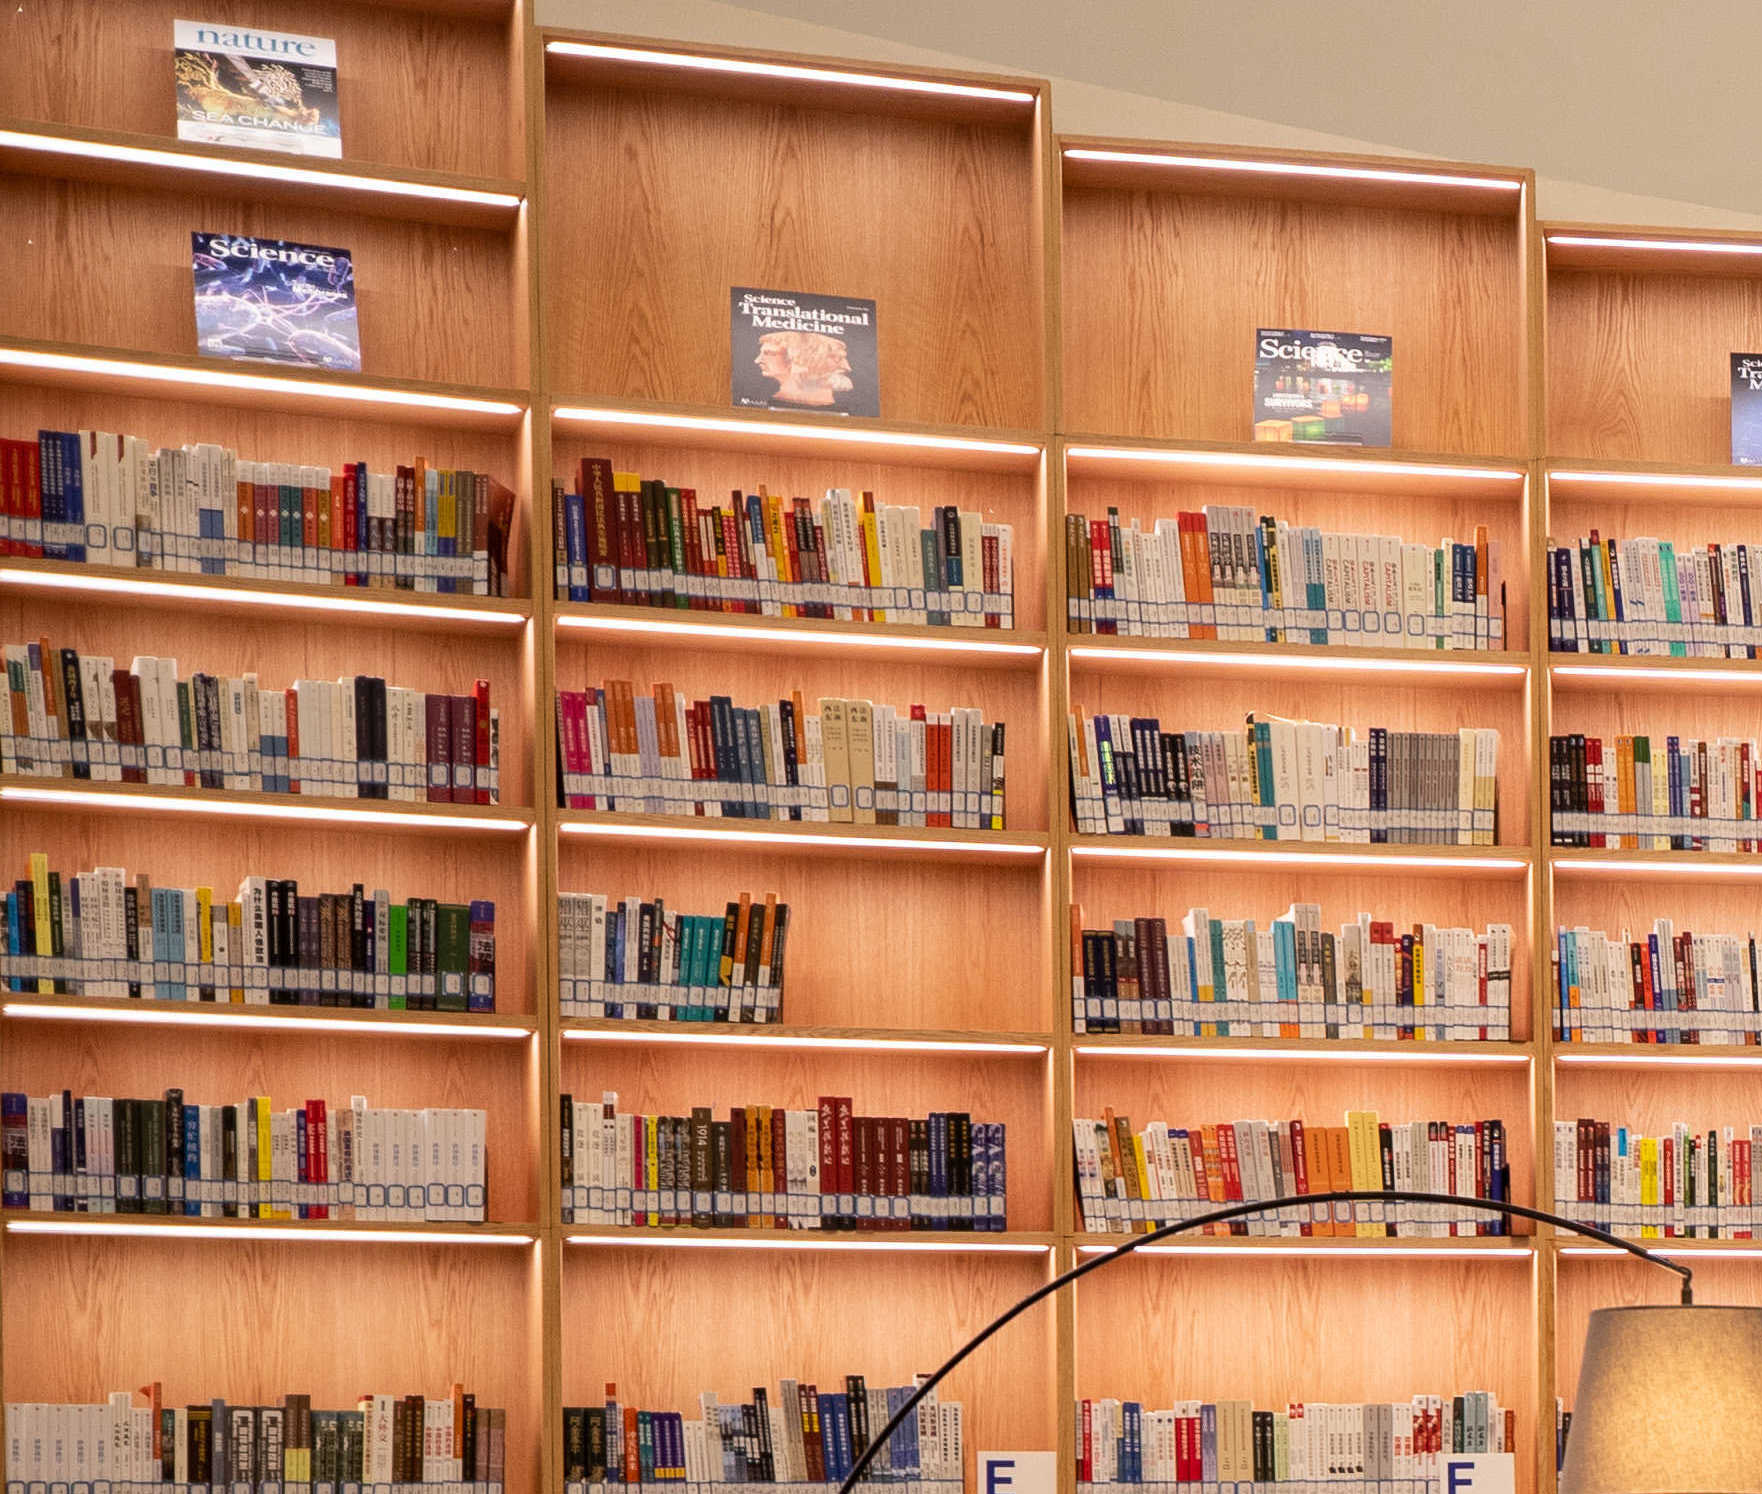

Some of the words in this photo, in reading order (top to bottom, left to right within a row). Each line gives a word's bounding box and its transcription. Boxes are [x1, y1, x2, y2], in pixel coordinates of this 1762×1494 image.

[196, 29, 316, 57] nature
[192, 110, 234, 124] SEA
[238, 115, 328, 135] CHANGE
[209, 239, 336, 268] Science
[743, 294, 796, 306] Science
[738, 301, 869, 326] Translational
[752, 315, 845, 335] Medicine
[697, 1124, 707, 1147] 1914
